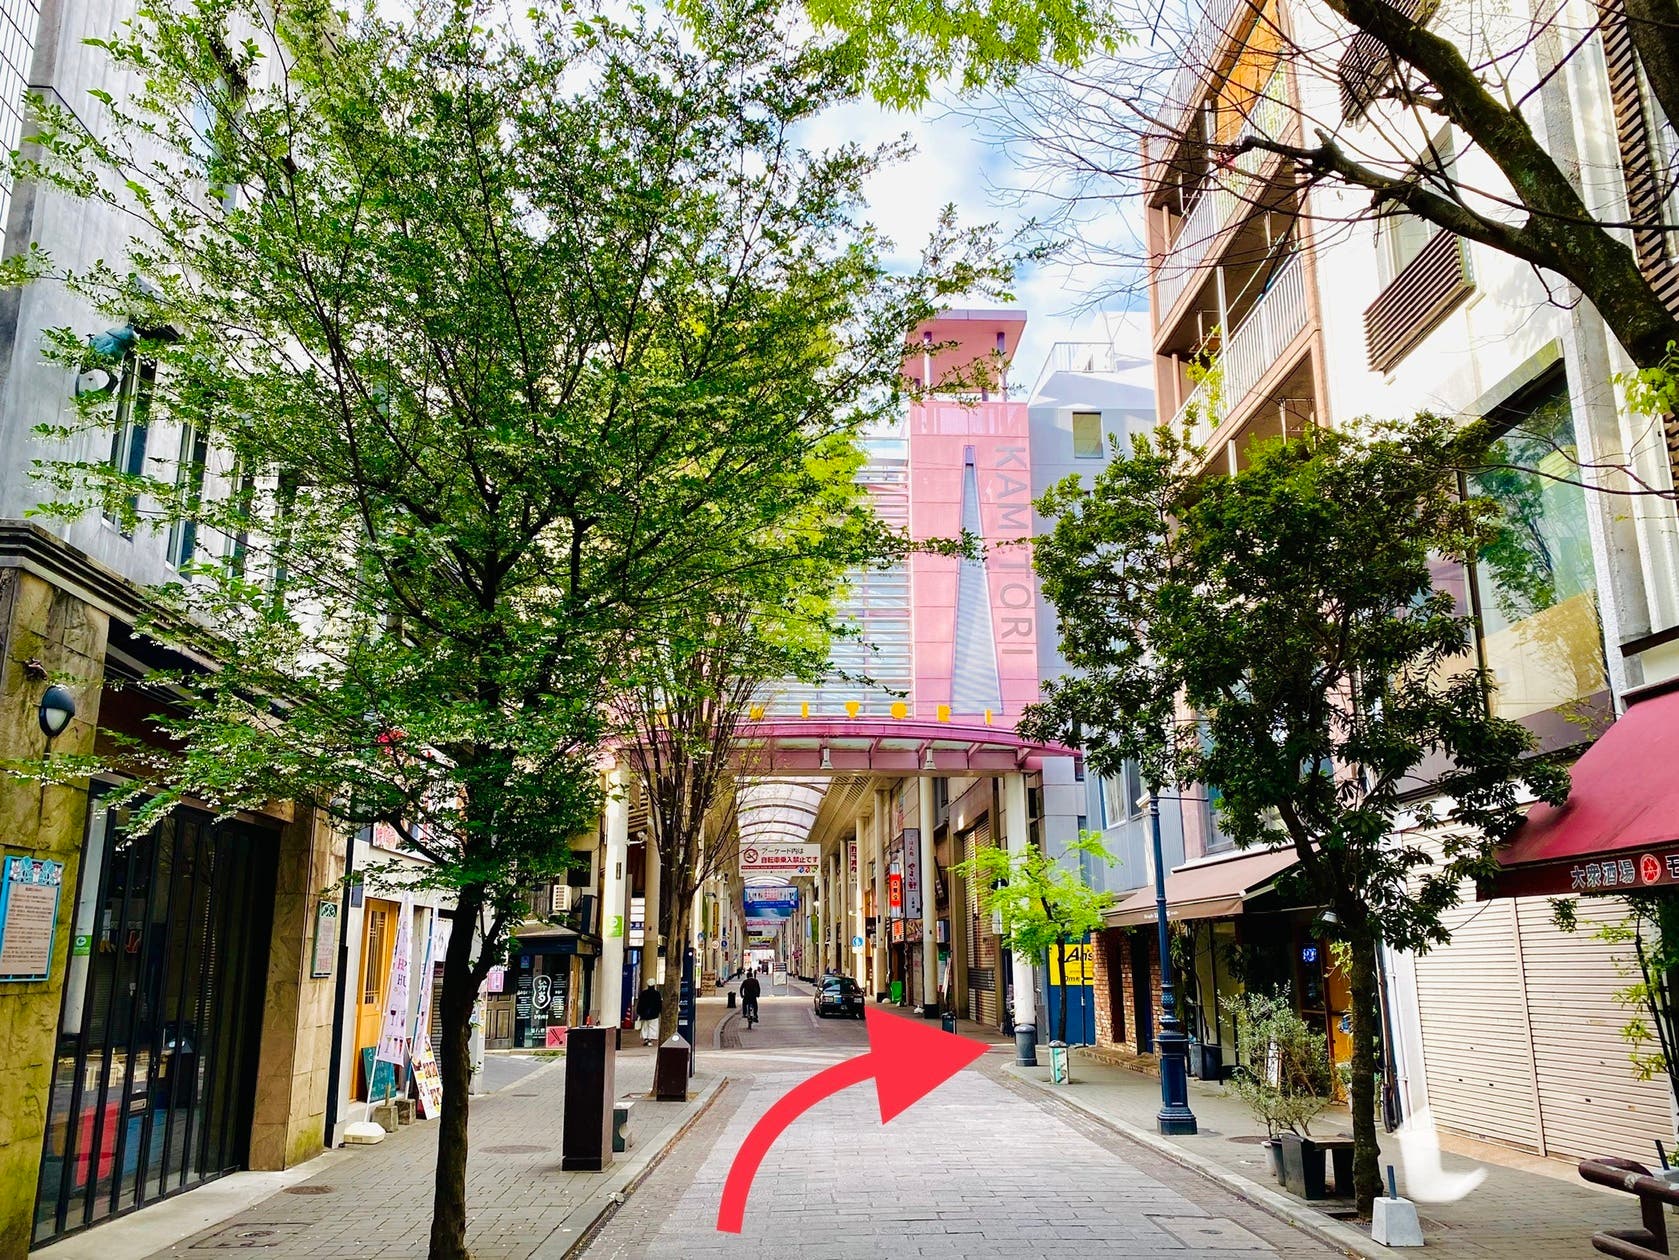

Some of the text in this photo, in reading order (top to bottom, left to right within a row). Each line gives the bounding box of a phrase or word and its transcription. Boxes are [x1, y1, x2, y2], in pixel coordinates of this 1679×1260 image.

[995, 447, 1033, 655] KAMTORI
[1570, 859, 1636, 889] 大衆酒場
